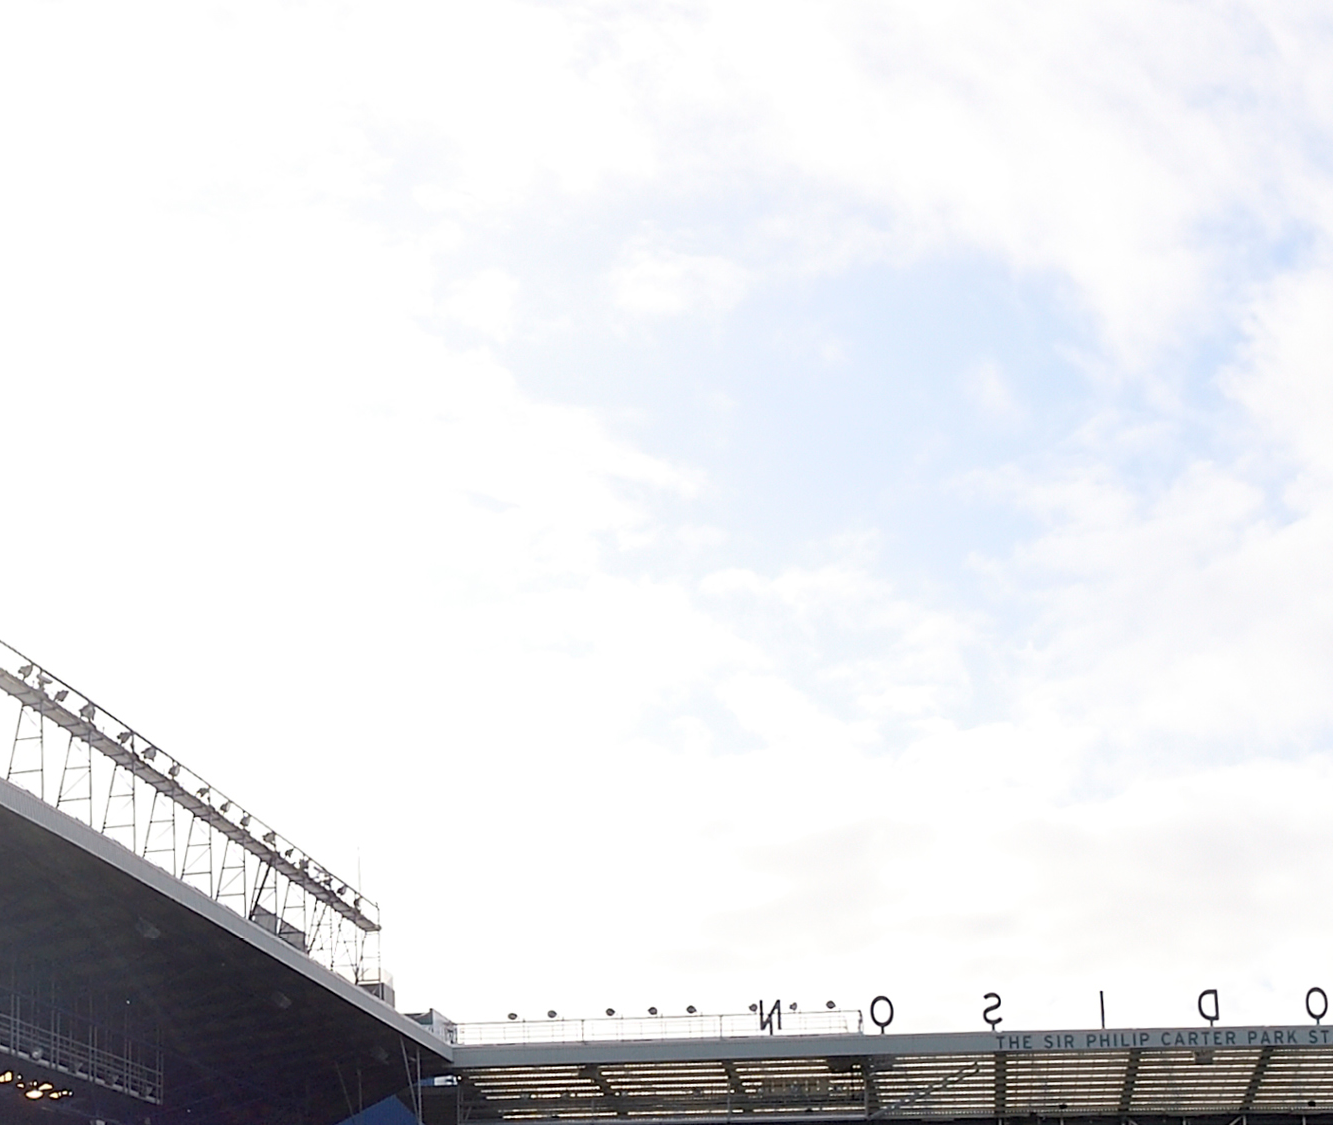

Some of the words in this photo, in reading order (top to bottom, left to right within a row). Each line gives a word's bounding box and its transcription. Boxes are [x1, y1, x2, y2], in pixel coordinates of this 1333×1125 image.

[996, 1036, 1032, 1049] THE
[1044, 1034, 1074, 1048] SIR
[1086, 1032, 1150, 1047] PHILIP
[1161, 1031, 1236, 1046] CARTER
[1247, 1029, 1296, 1045] PARK
[1308, 1029, 1333, 1044] ST
